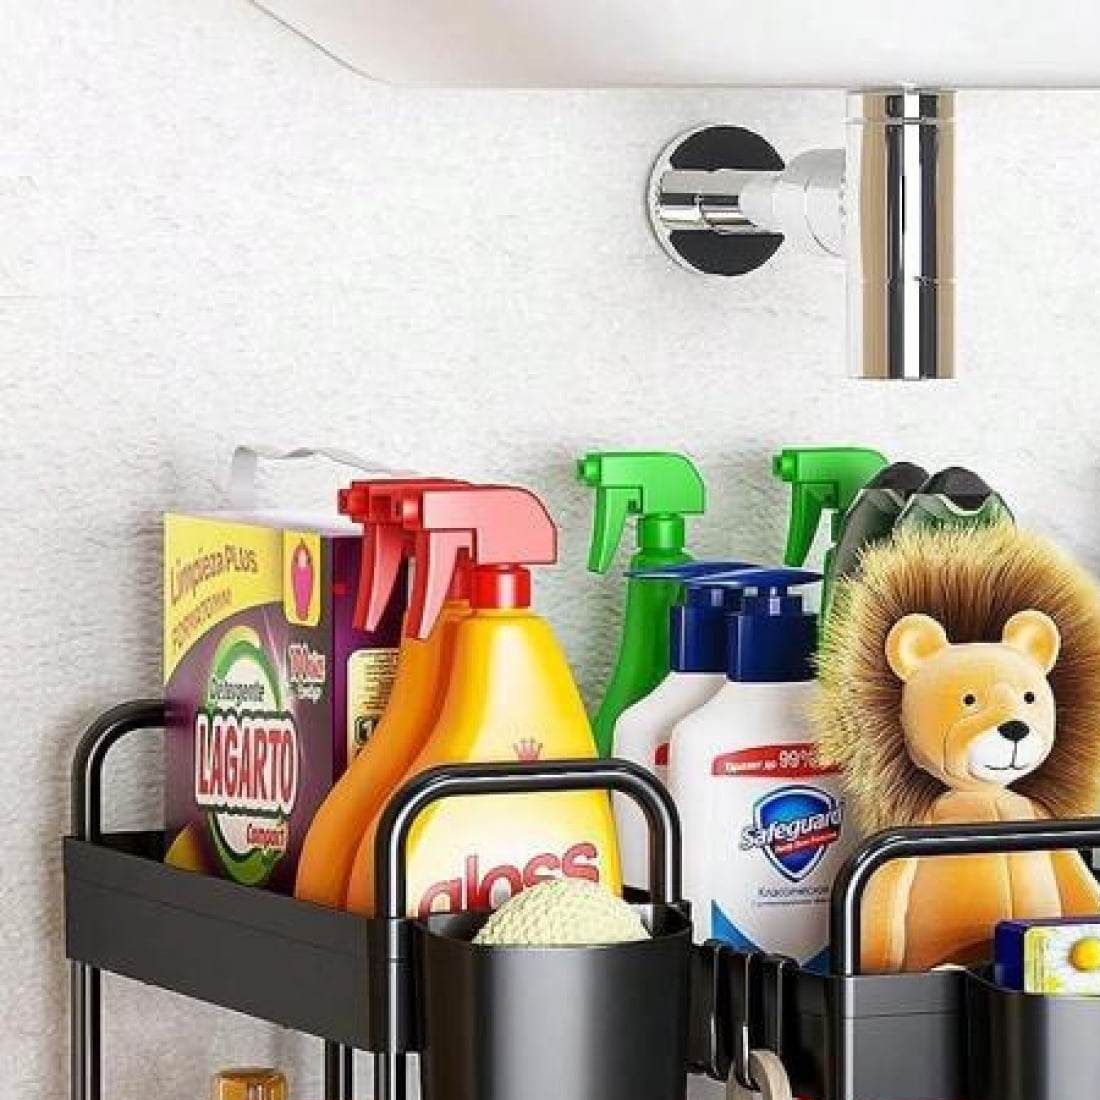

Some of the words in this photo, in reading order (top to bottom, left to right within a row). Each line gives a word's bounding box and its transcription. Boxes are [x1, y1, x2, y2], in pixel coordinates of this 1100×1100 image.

[224, 545, 258, 573] PLUS
[198, 722, 295, 804] LAGARTO
[741, 797, 843, 851] Safeguard
